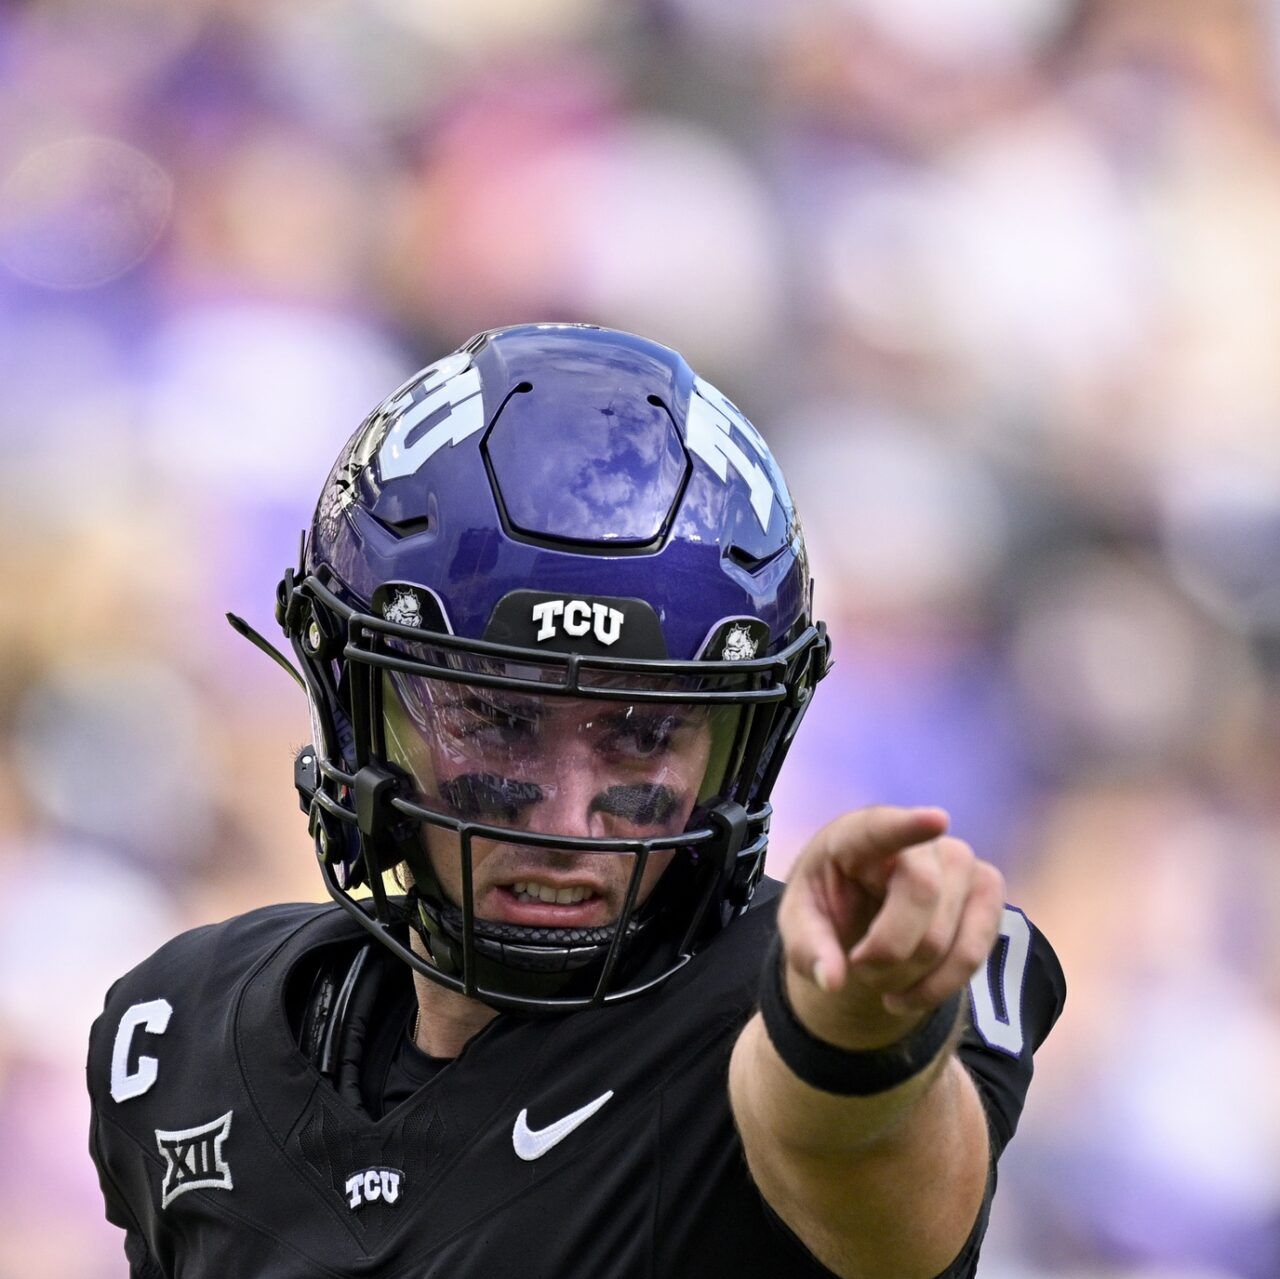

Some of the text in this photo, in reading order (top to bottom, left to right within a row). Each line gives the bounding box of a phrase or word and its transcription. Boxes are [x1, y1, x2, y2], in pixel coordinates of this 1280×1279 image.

[532, 599, 625, 646] TCU
[968, 902, 1035, 1060] 0
[109, 998, 174, 1104] C
[158, 1118, 229, 1202] XII
[345, 1170, 401, 1209] TCU
